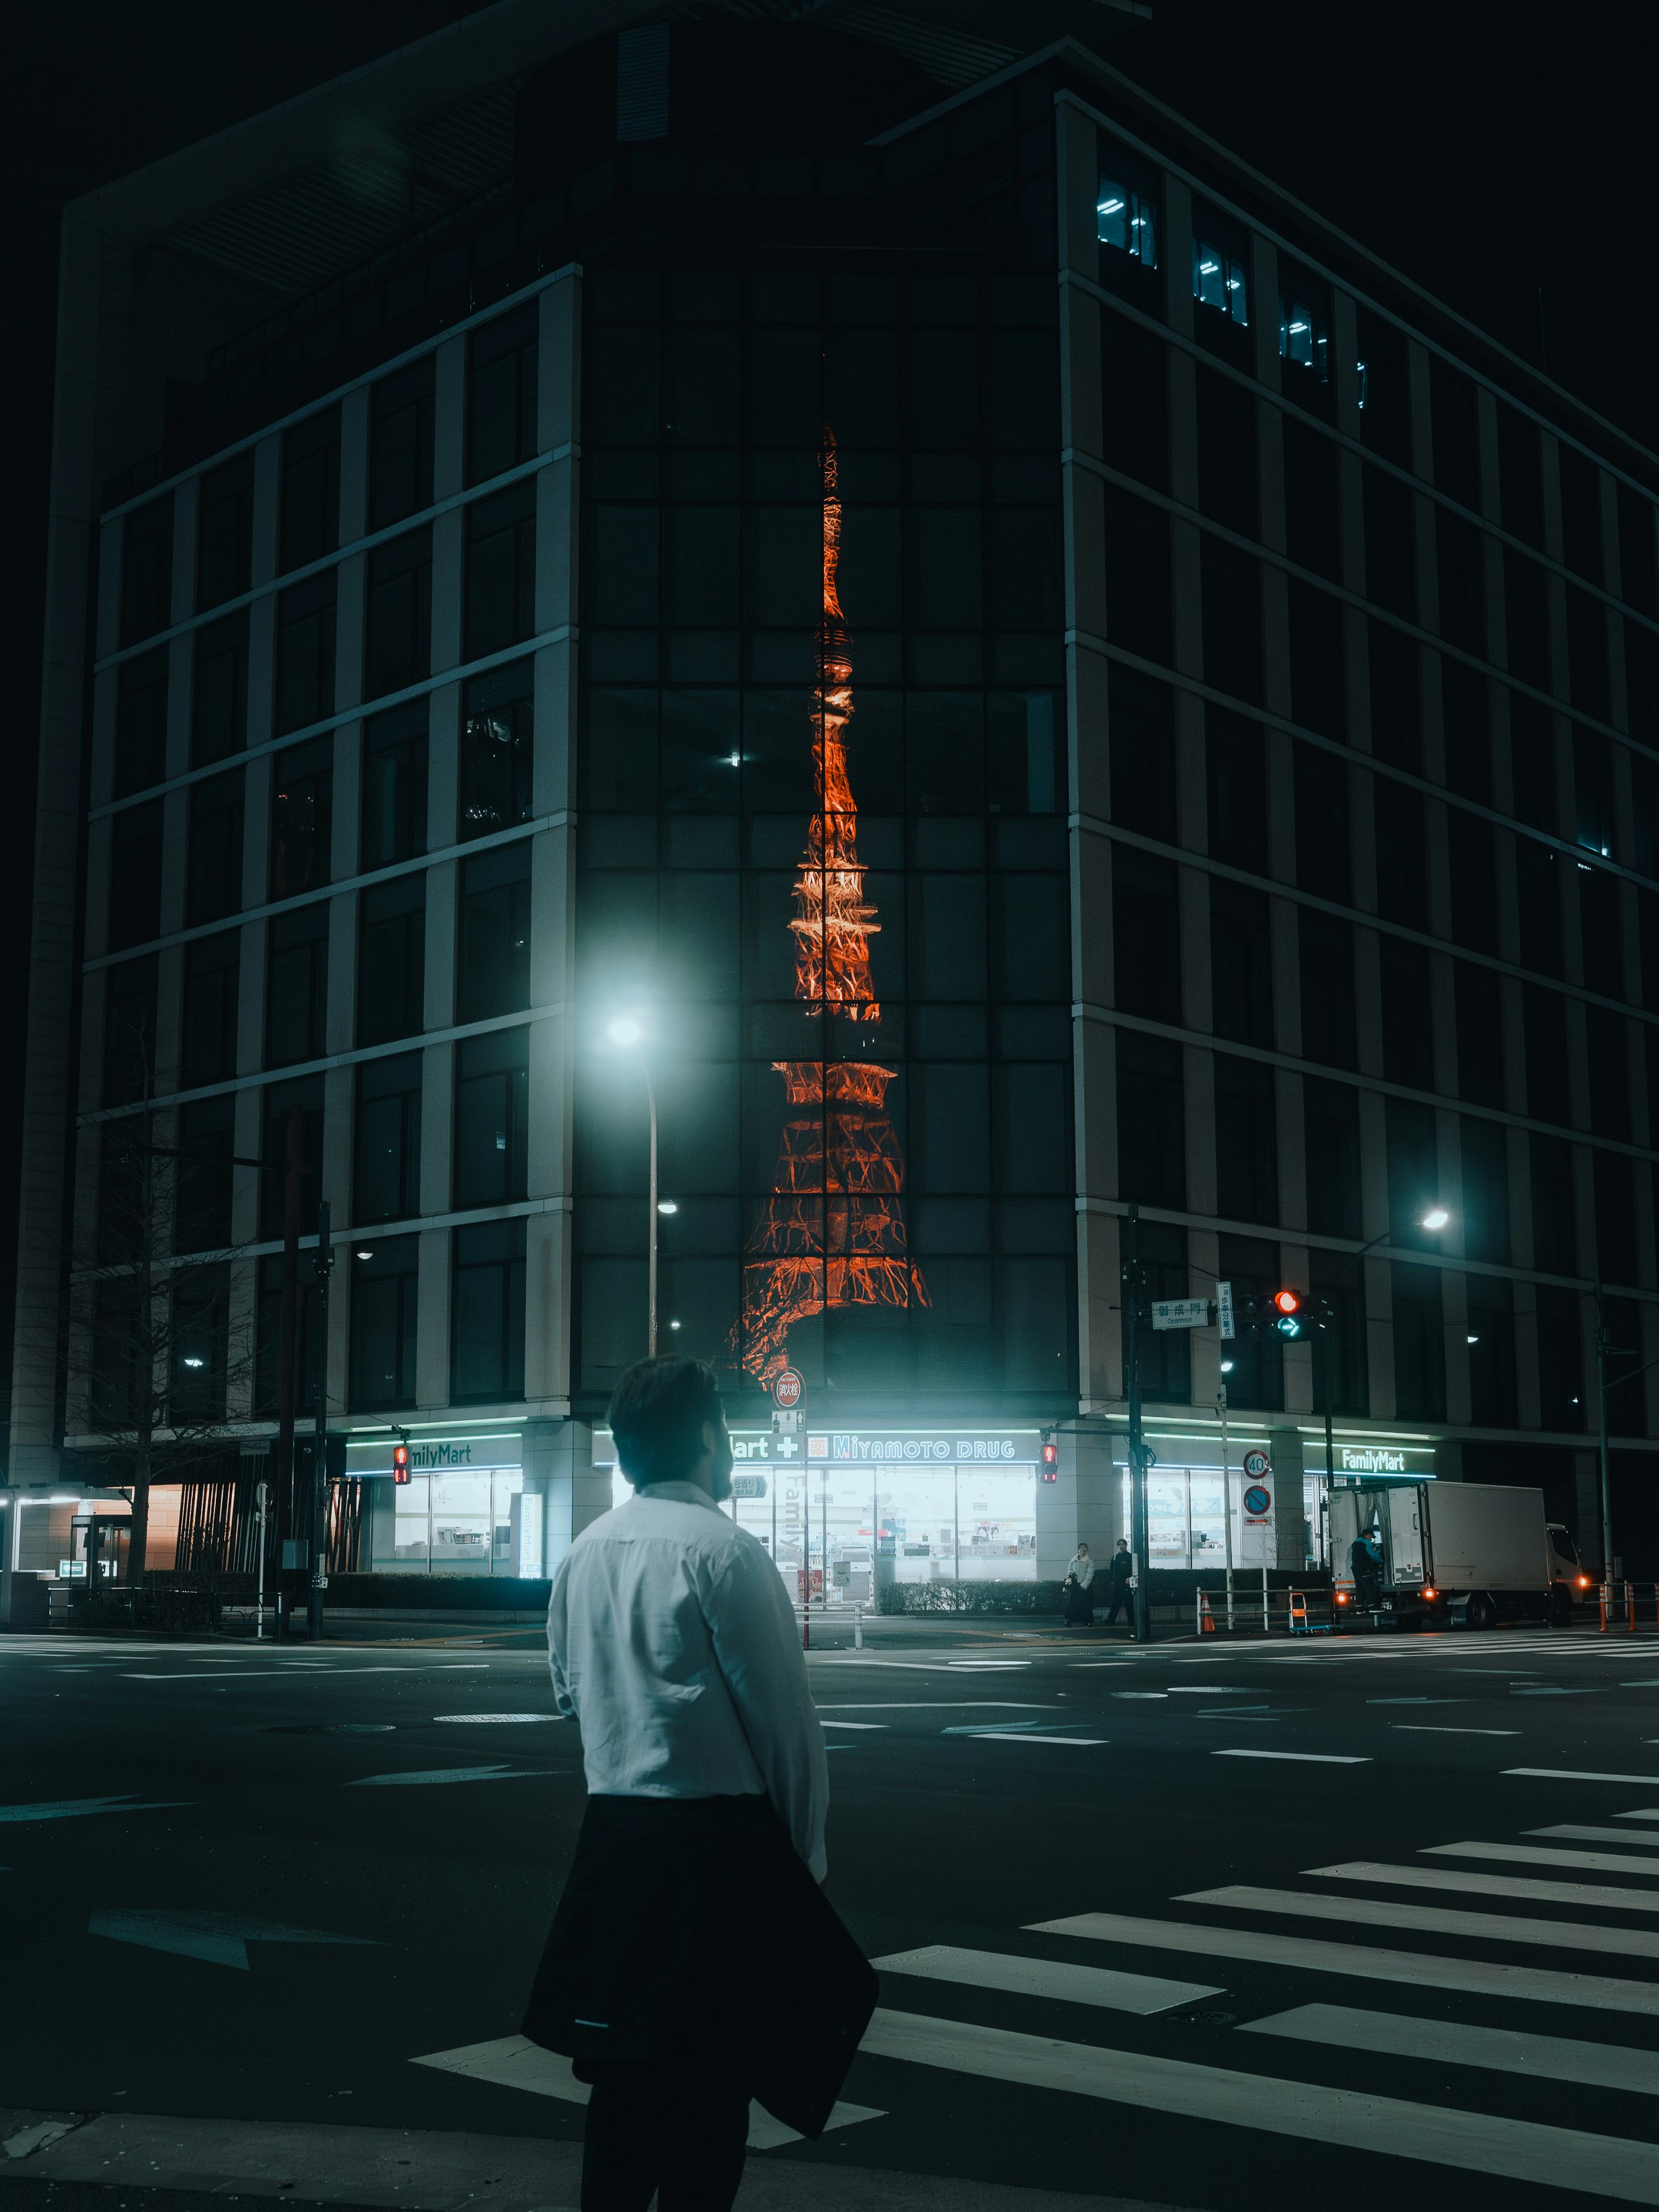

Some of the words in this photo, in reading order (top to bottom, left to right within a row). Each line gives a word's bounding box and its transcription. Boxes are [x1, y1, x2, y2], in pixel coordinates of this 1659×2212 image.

[1158, 1303, 1200, 1316] 御成門
[779, 1382, 799, 1396] 消火栓
[412, 1444, 472, 1468] milyMart
[729, 1435, 769, 1459] art
[957, 1441, 1015, 1459] DRUG
[1249, 1458, 1263, 1472] 40
[1342, 1449, 1405, 1473] FamilyMart
[733, 1479, 754, 1488] 谷通り
[522, 1498, 533, 1561] FamilyMart
